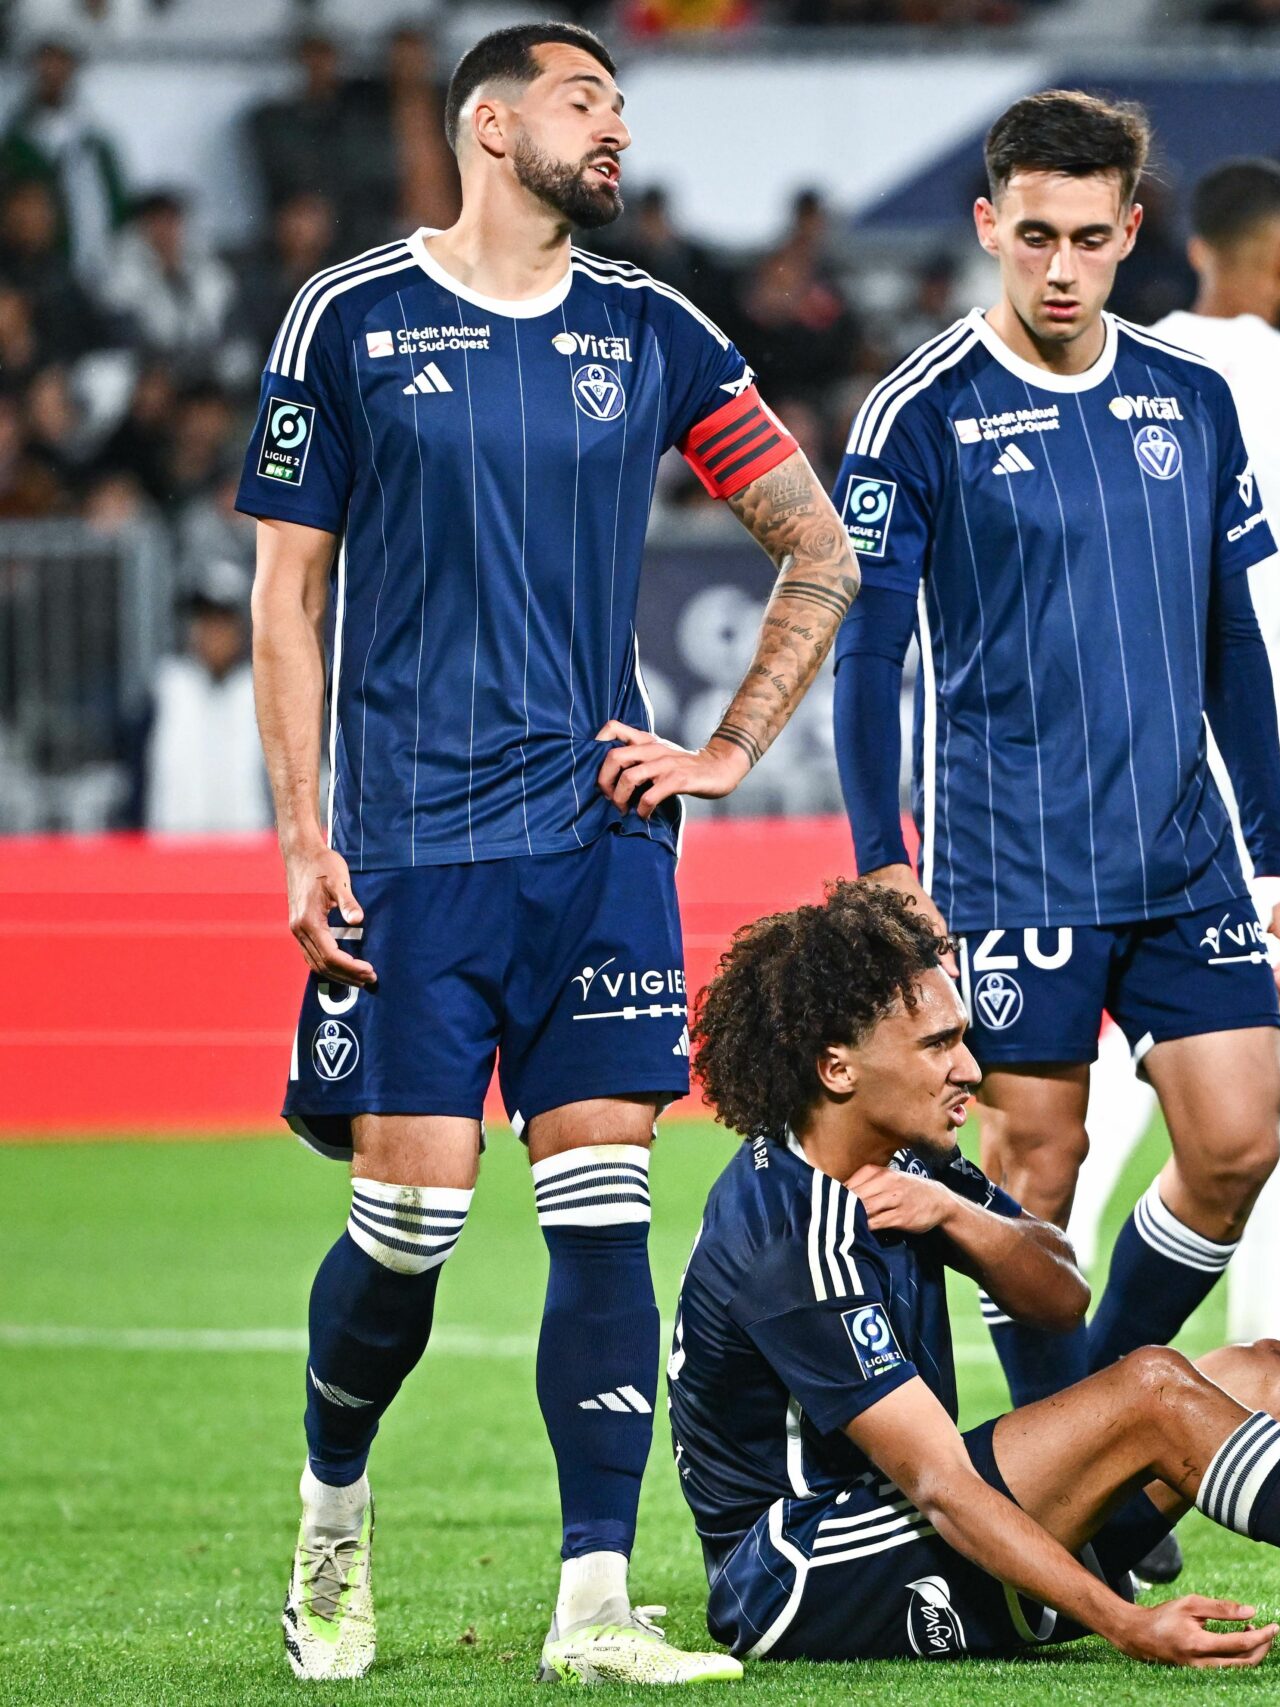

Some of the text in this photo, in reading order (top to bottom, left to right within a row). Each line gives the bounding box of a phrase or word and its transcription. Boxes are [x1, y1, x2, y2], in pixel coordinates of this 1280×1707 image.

[396, 325, 491, 341] Crédit Mutuel
[398, 338, 490, 354] du Sud-Ouest
[570, 332, 632, 362] Vital
[979, 404, 1060, 429] Crédit Mutuel
[1123, 395, 1184, 421] Vital
[983, 418, 1060, 441] du Sud-Ouest
[264, 449, 301, 467] LIGUE 2
[845, 524, 883, 539] LIGUE 2
[1224, 920, 1267, 946] VIG
[754, 1147, 769, 1171] BAT
[864, 1351, 901, 1368] LIGUE 2
[920, 1602, 950, 1655] eyva
